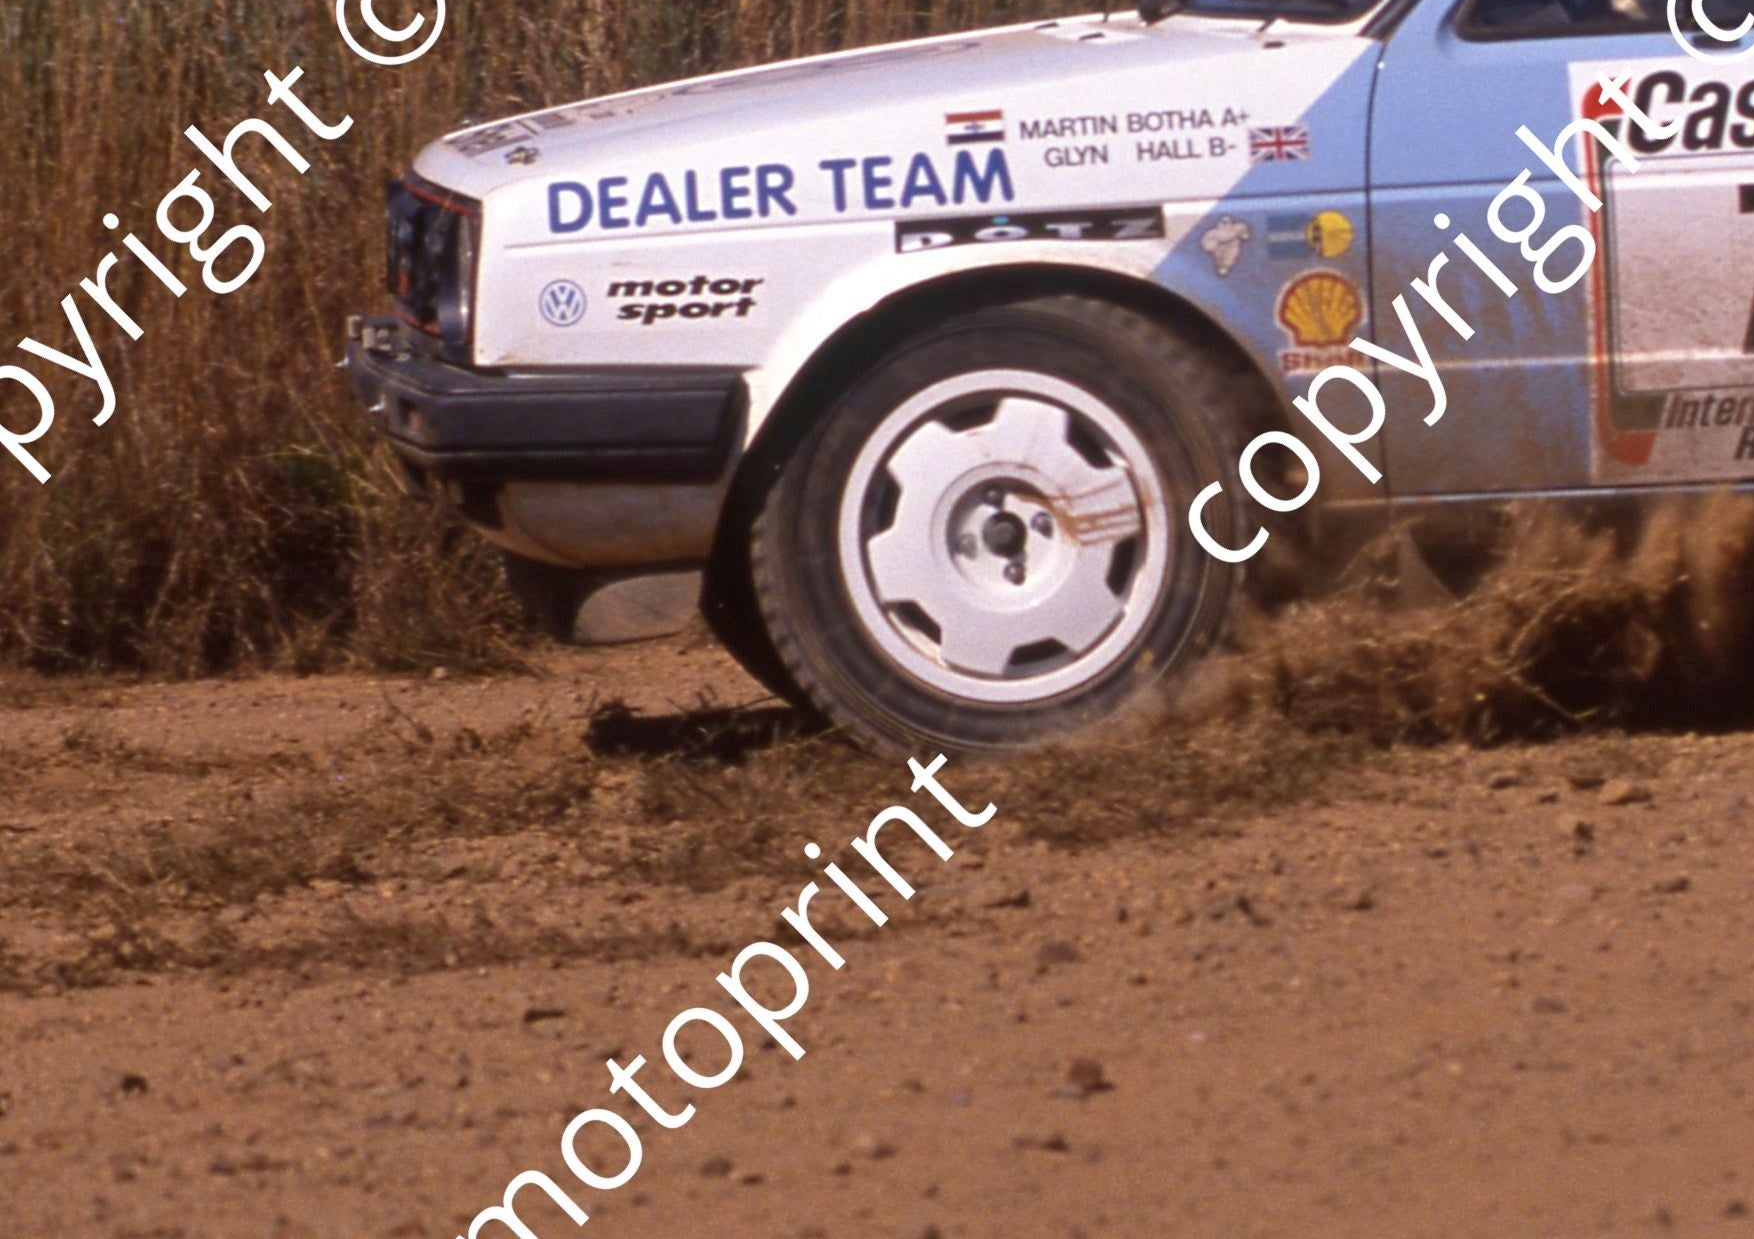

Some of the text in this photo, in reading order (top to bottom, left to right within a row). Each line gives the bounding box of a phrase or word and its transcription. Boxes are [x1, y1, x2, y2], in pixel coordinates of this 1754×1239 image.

[1019, 107, 1250, 140] MARTIN BOTHA A+
[1044, 143, 1109, 168] GLYN
[1136, 139, 1200, 162] HALL
[547, 148, 1015, 234] DEALER TEAM
[901, 216, 1163, 252] DOTZ
[607, 275, 765, 298] motor
[616, 297, 757, 326] sport
